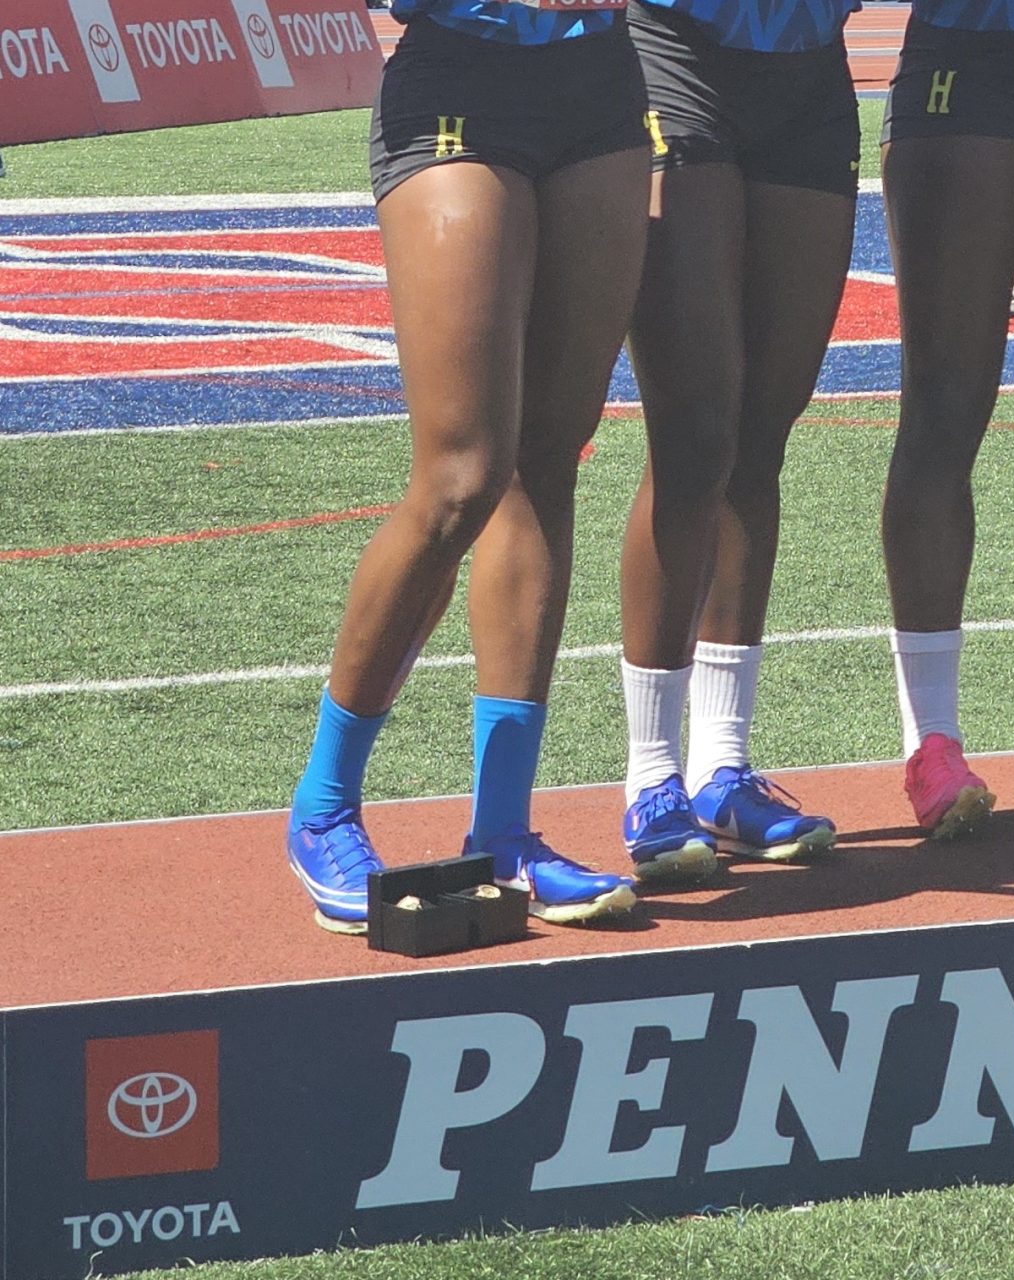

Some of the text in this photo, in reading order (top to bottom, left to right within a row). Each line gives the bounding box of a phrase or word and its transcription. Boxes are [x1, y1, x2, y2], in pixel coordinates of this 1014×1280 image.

[0, 11, 374, 79] OTA TOYOTA TOYOTA
[926, 70, 958, 114] H
[436, 116, 466, 157] H
[63, 1201, 241, 1250] TOYOTA
